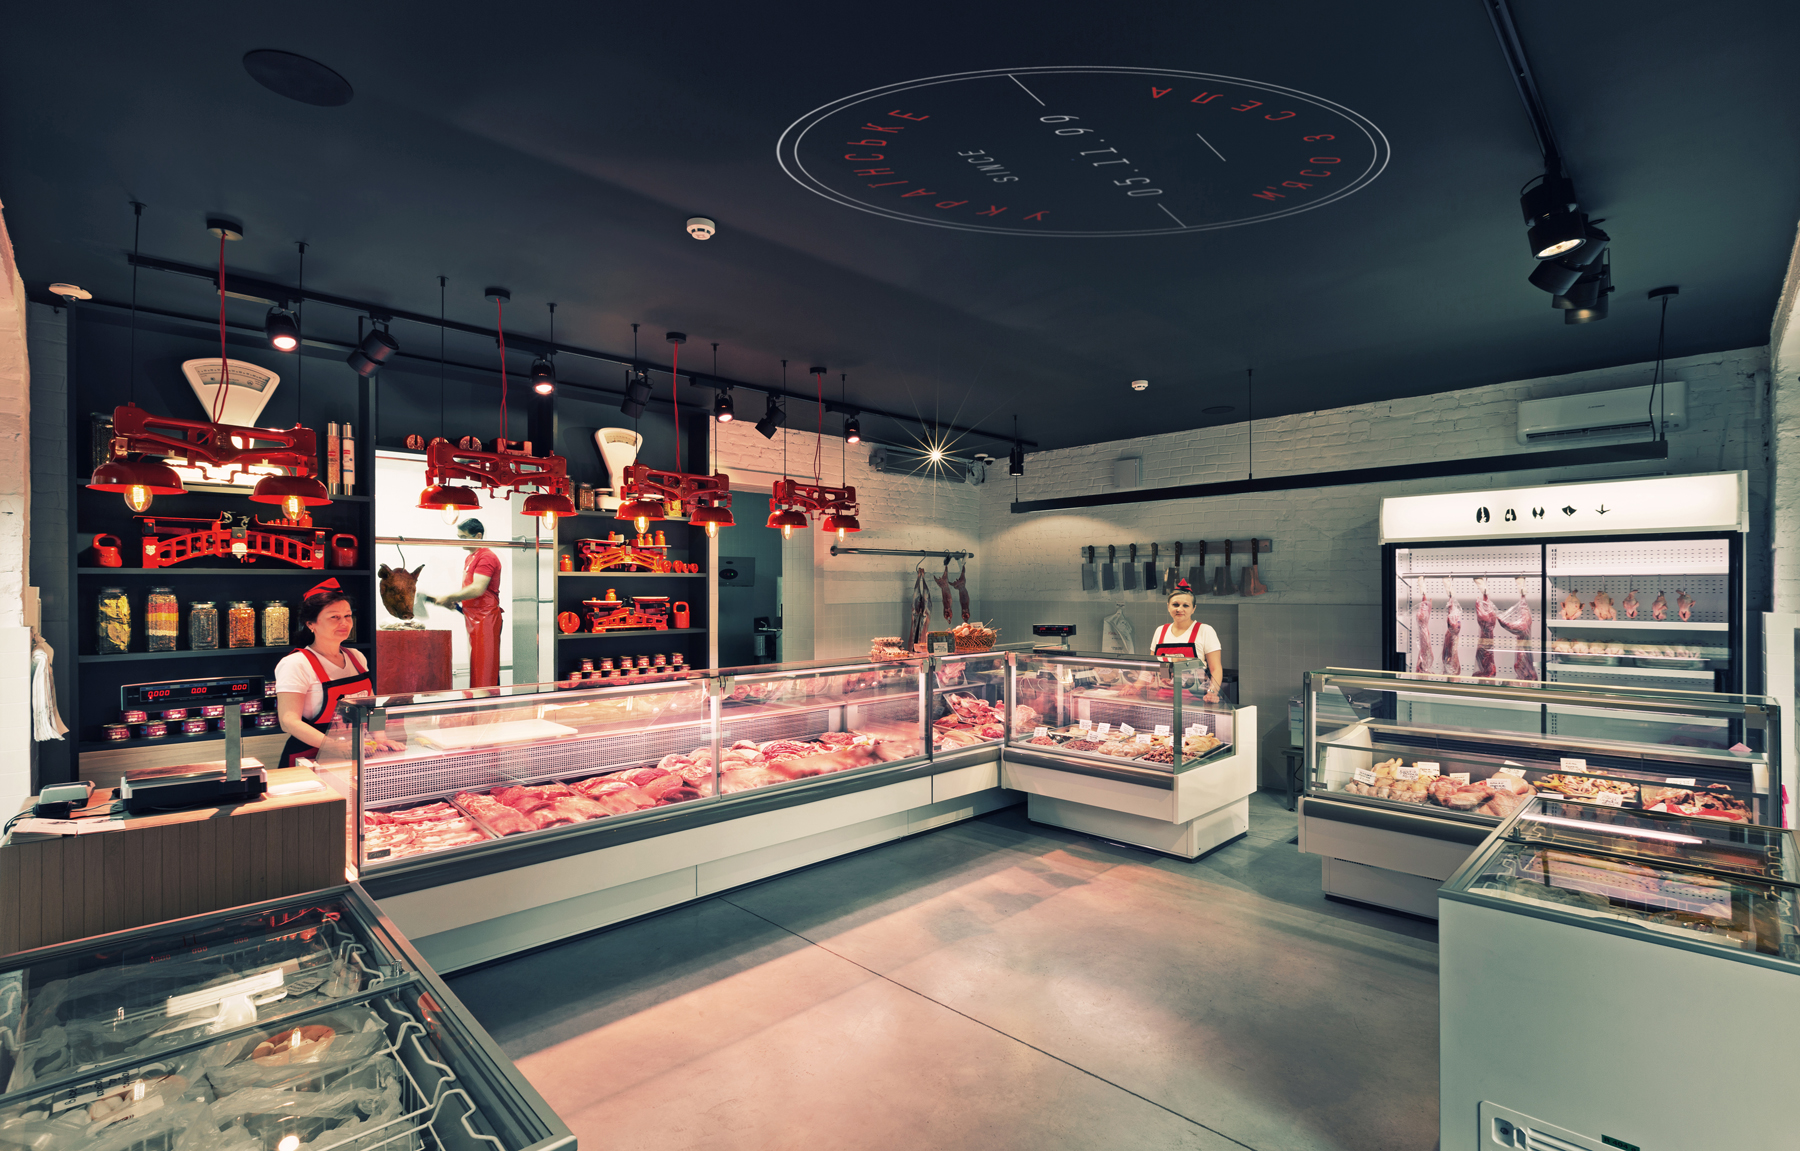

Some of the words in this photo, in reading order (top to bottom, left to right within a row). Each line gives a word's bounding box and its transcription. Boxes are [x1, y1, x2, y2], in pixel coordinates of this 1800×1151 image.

[1151, 86, 1297, 122] СЕЛА
[844, 109, 1050, 222] УКРАЇНСЬКЕ
[957, 149, 1020, 184] SINCE
[1039, 115, 1163, 197] 05.11.99
